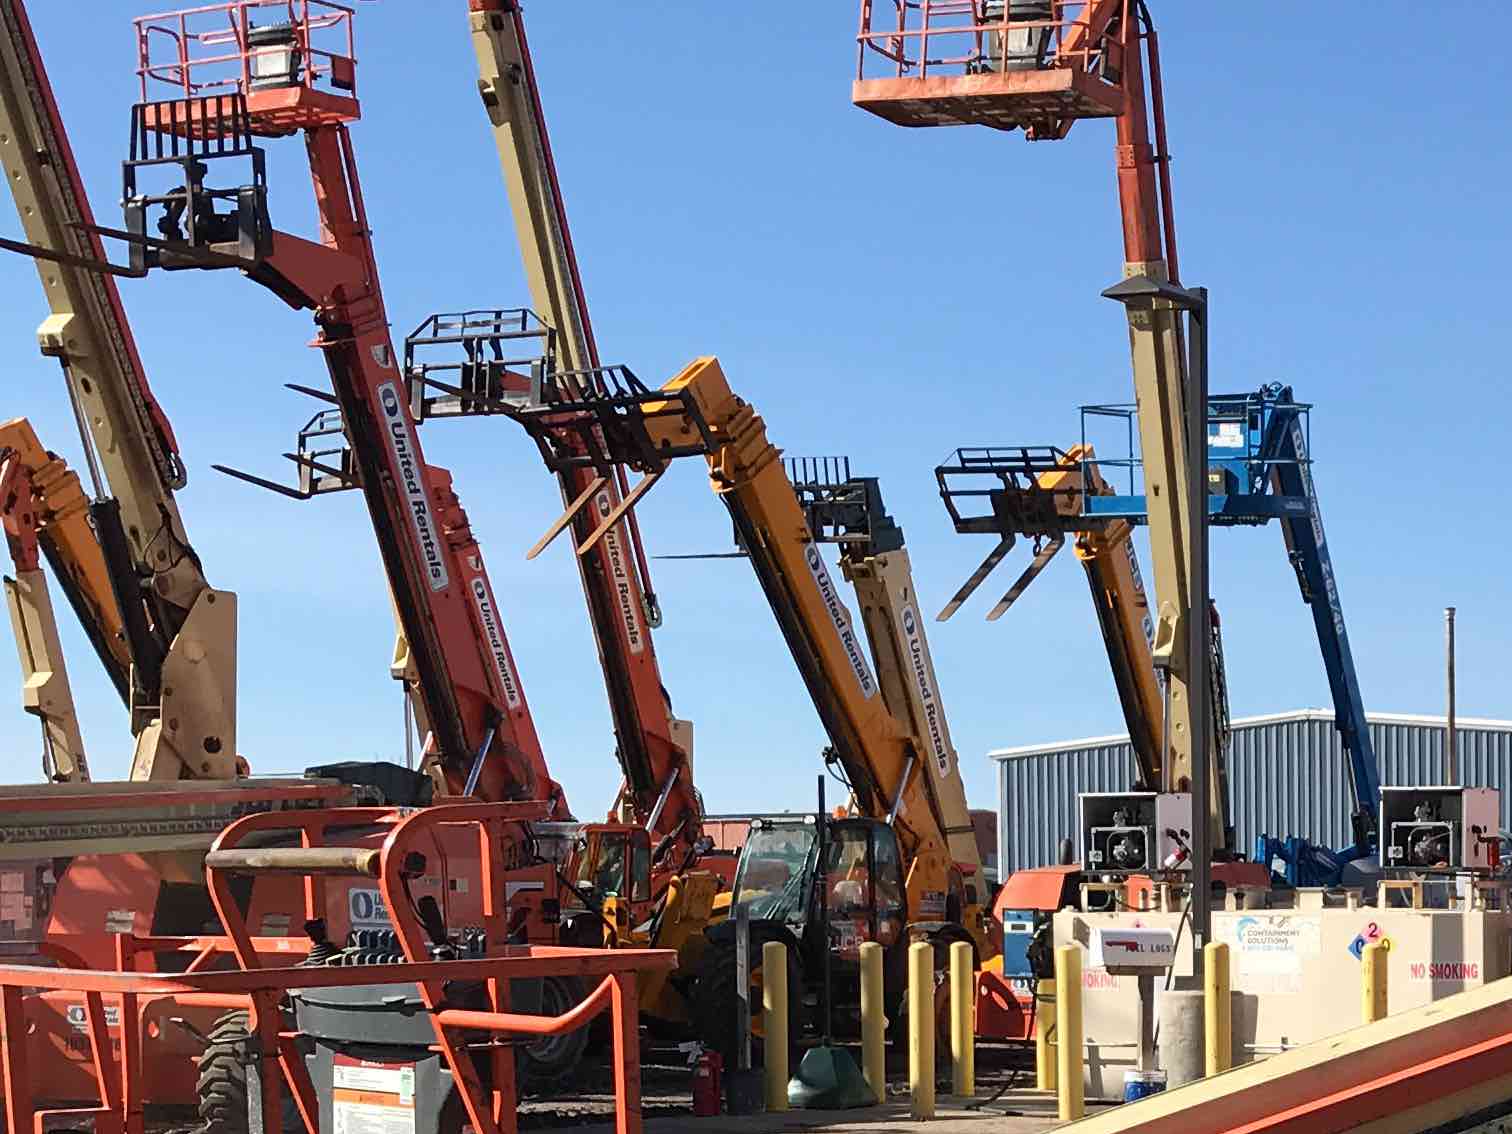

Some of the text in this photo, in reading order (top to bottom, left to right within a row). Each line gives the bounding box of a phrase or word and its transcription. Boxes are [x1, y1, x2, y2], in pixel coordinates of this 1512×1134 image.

[390, 422, 443, 580] United Rentals
[479, 600, 517, 703] United Rentals
[618, 583, 639, 645] Rentals
[817, 572, 872, 692] United Rentals
[910, 638, 948, 770] United Rentals
[1368, 922, 1378, 938] 2
[1410, 963, 1478, 979] NO SMOKING
